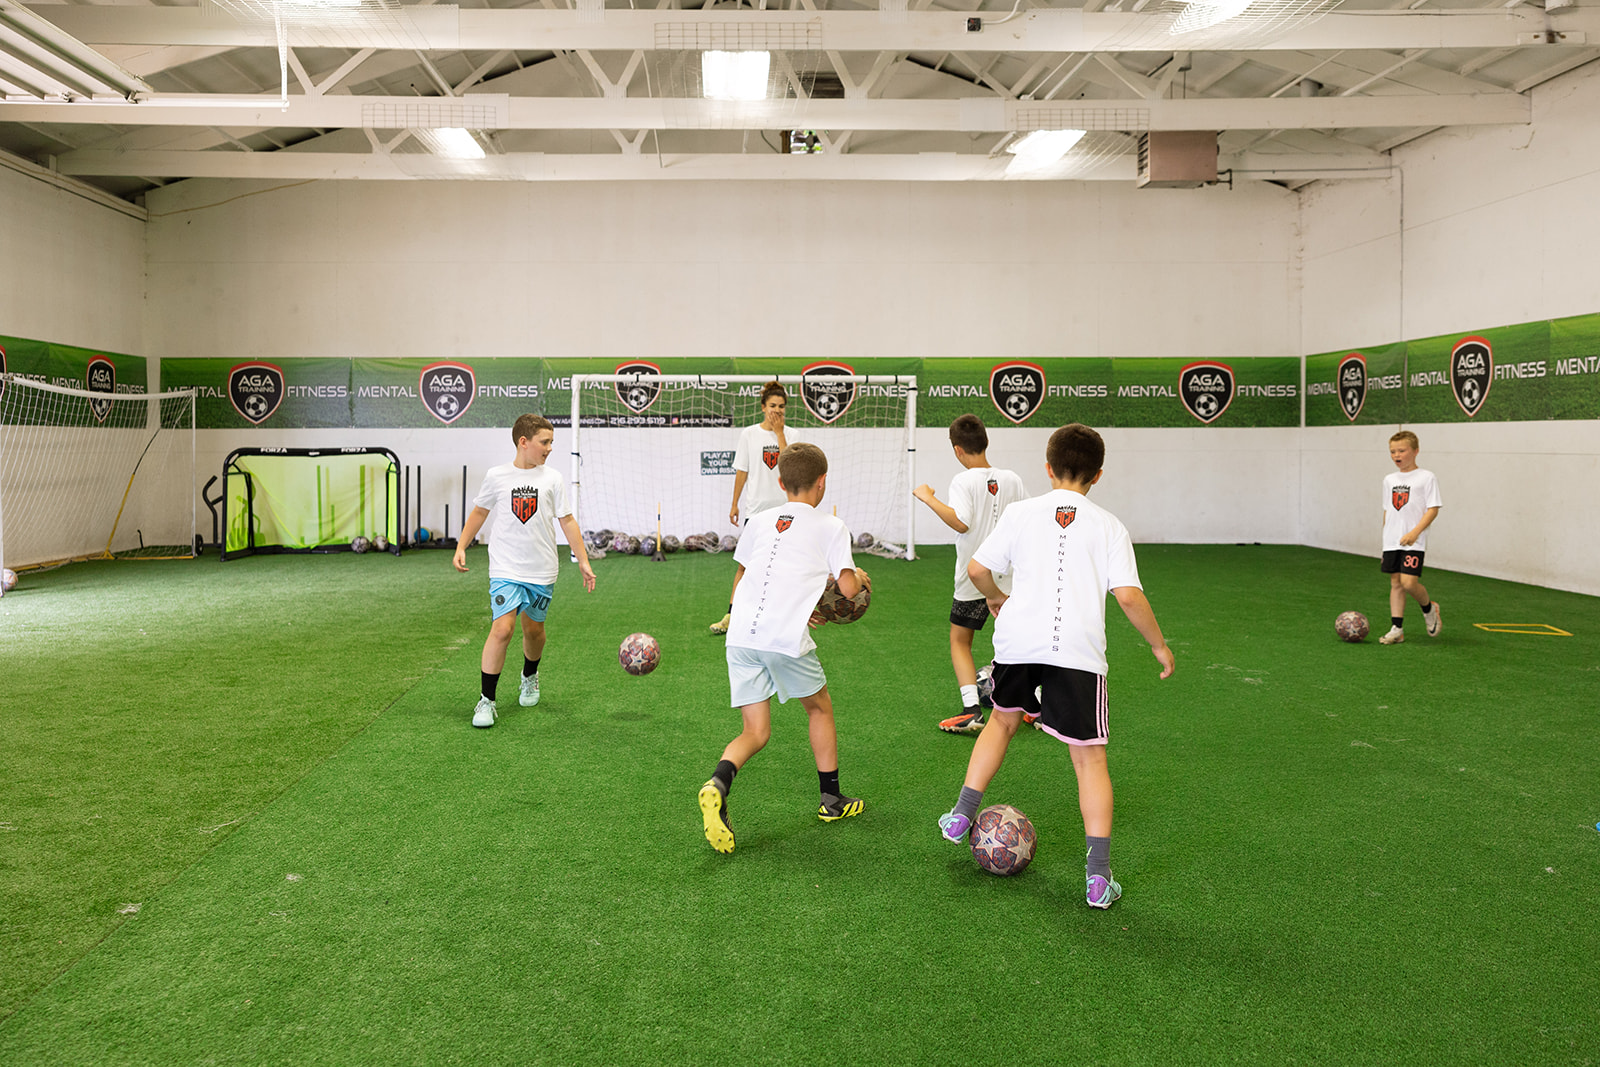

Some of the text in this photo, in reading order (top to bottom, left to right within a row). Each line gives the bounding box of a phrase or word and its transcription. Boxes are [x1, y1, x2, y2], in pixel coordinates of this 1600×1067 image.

[1457, 353, 1485, 369] AGA
[92, 369, 111, 382] AGA
[1342, 367, 1362, 380] AGA
[1410, 361, 1546, 387] MENTAL FITNESS
[1457, 368, 1485, 376] TRAINING
[238, 375, 274, 386] AGA
[429, 375, 466, 386] AGA
[1000, 374, 1036, 386] AGA
[1188, 374, 1224, 386] AGA
[1307, 375, 1402, 396] MENTAL FITNESS
[287, 385, 347, 398] FITNESS
[357, 385, 538, 398] MENTAL FITNESS
[858, 385, 909, 397] FITNES
[928, 385, 1108, 397] MENTAL FITNESS
[1117, 385, 1296, 397] MENTAL FITNESS
[513, 497, 537, 522] AGA
[1403, 555, 1419, 568] 30
[1052, 534, 1067, 652] MENTAL FITNESS
[532, 593, 550, 611] 10
